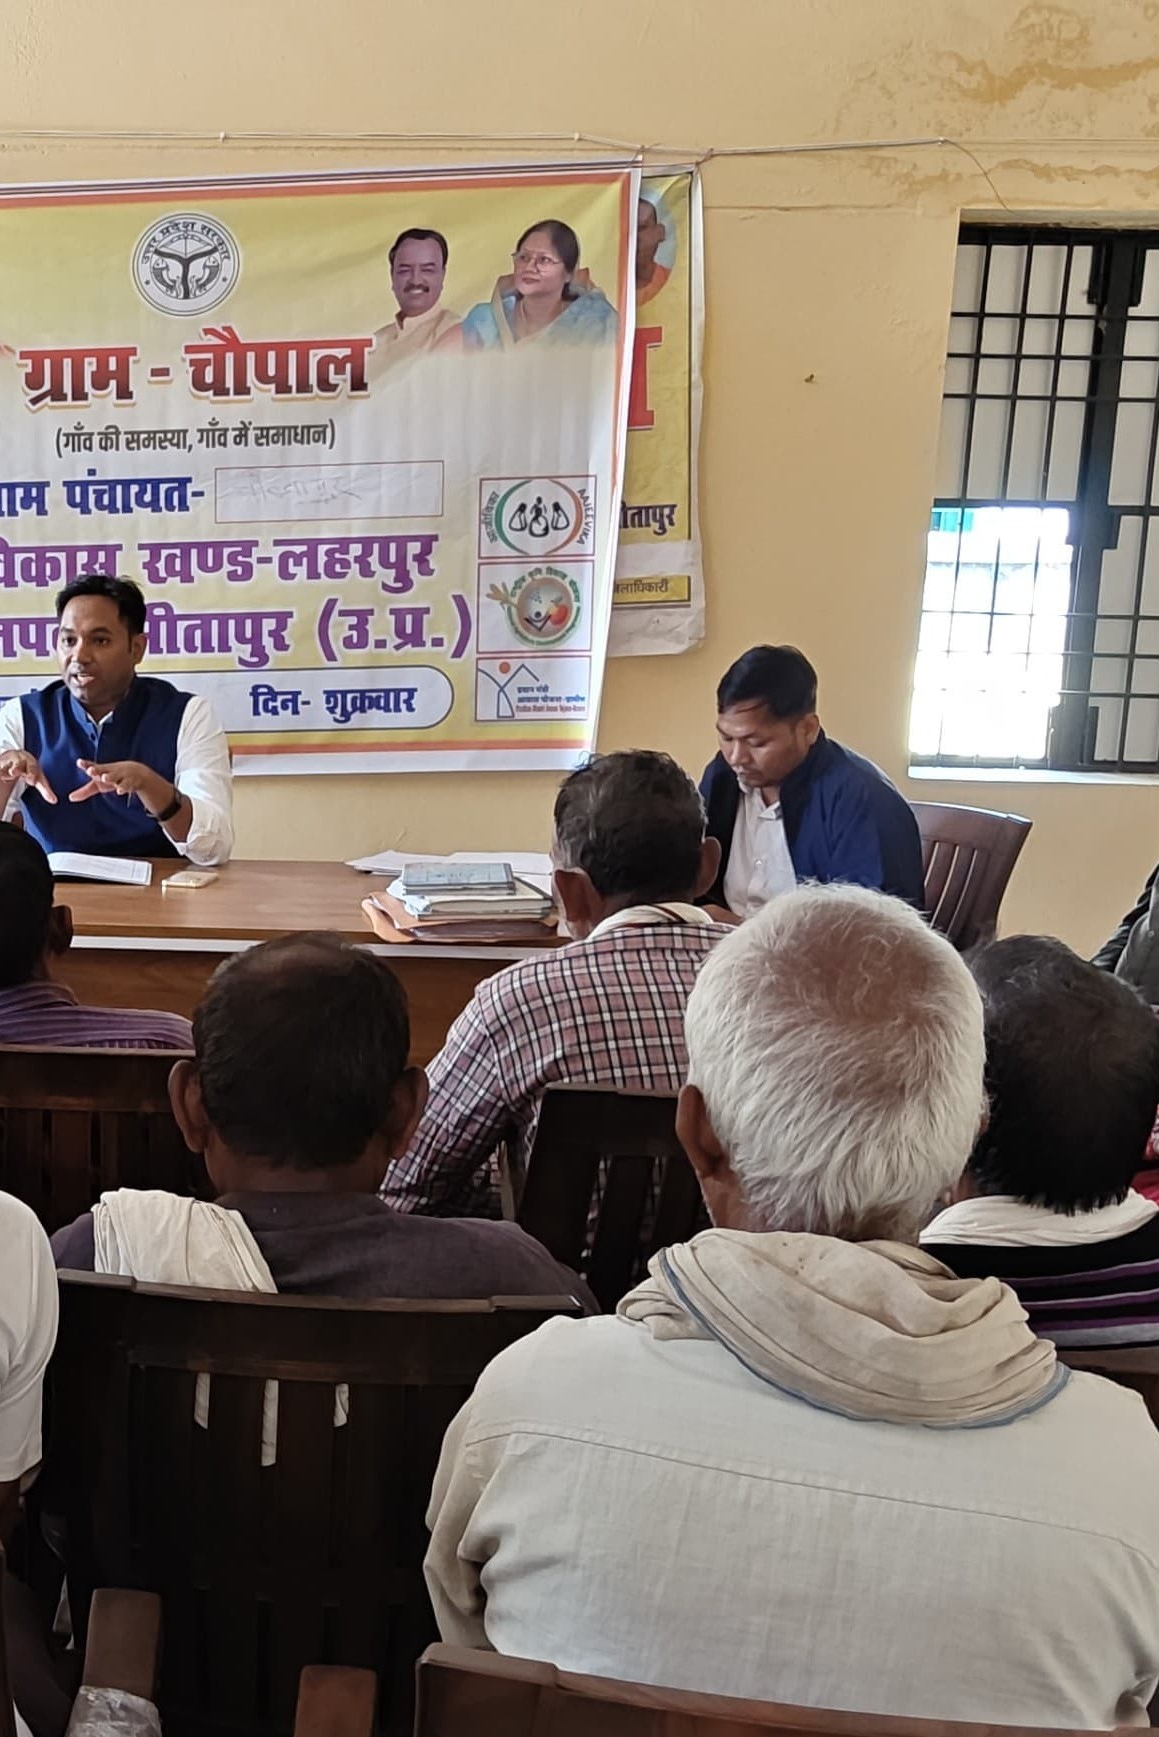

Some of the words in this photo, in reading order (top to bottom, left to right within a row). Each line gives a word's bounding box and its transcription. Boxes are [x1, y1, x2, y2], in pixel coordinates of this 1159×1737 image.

[19, 347, 137, 405] ग्राम
[184, 326, 373, 396] चौपाल
[56, 422, 93, 458] (गाँव
[98, 425, 121, 452] की
[124, 428, 193, 453] समस्या,
[197, 417, 229, 449] गाँव
[232, 421, 252, 447] में
[253, 419, 336, 449] समाधान)
[63, 469, 205, 515] पंचायत-
[577, 489, 594, 545] AAJEEVIKA
[619, 501, 677, 536] ीतापुर
[613, 578, 669, 594] लाधिकारी
[145, 602, 293, 668] ीतापुर
[249, 684, 311, 717] दिन-
[323, 688, 418, 724] शुक्रवार
